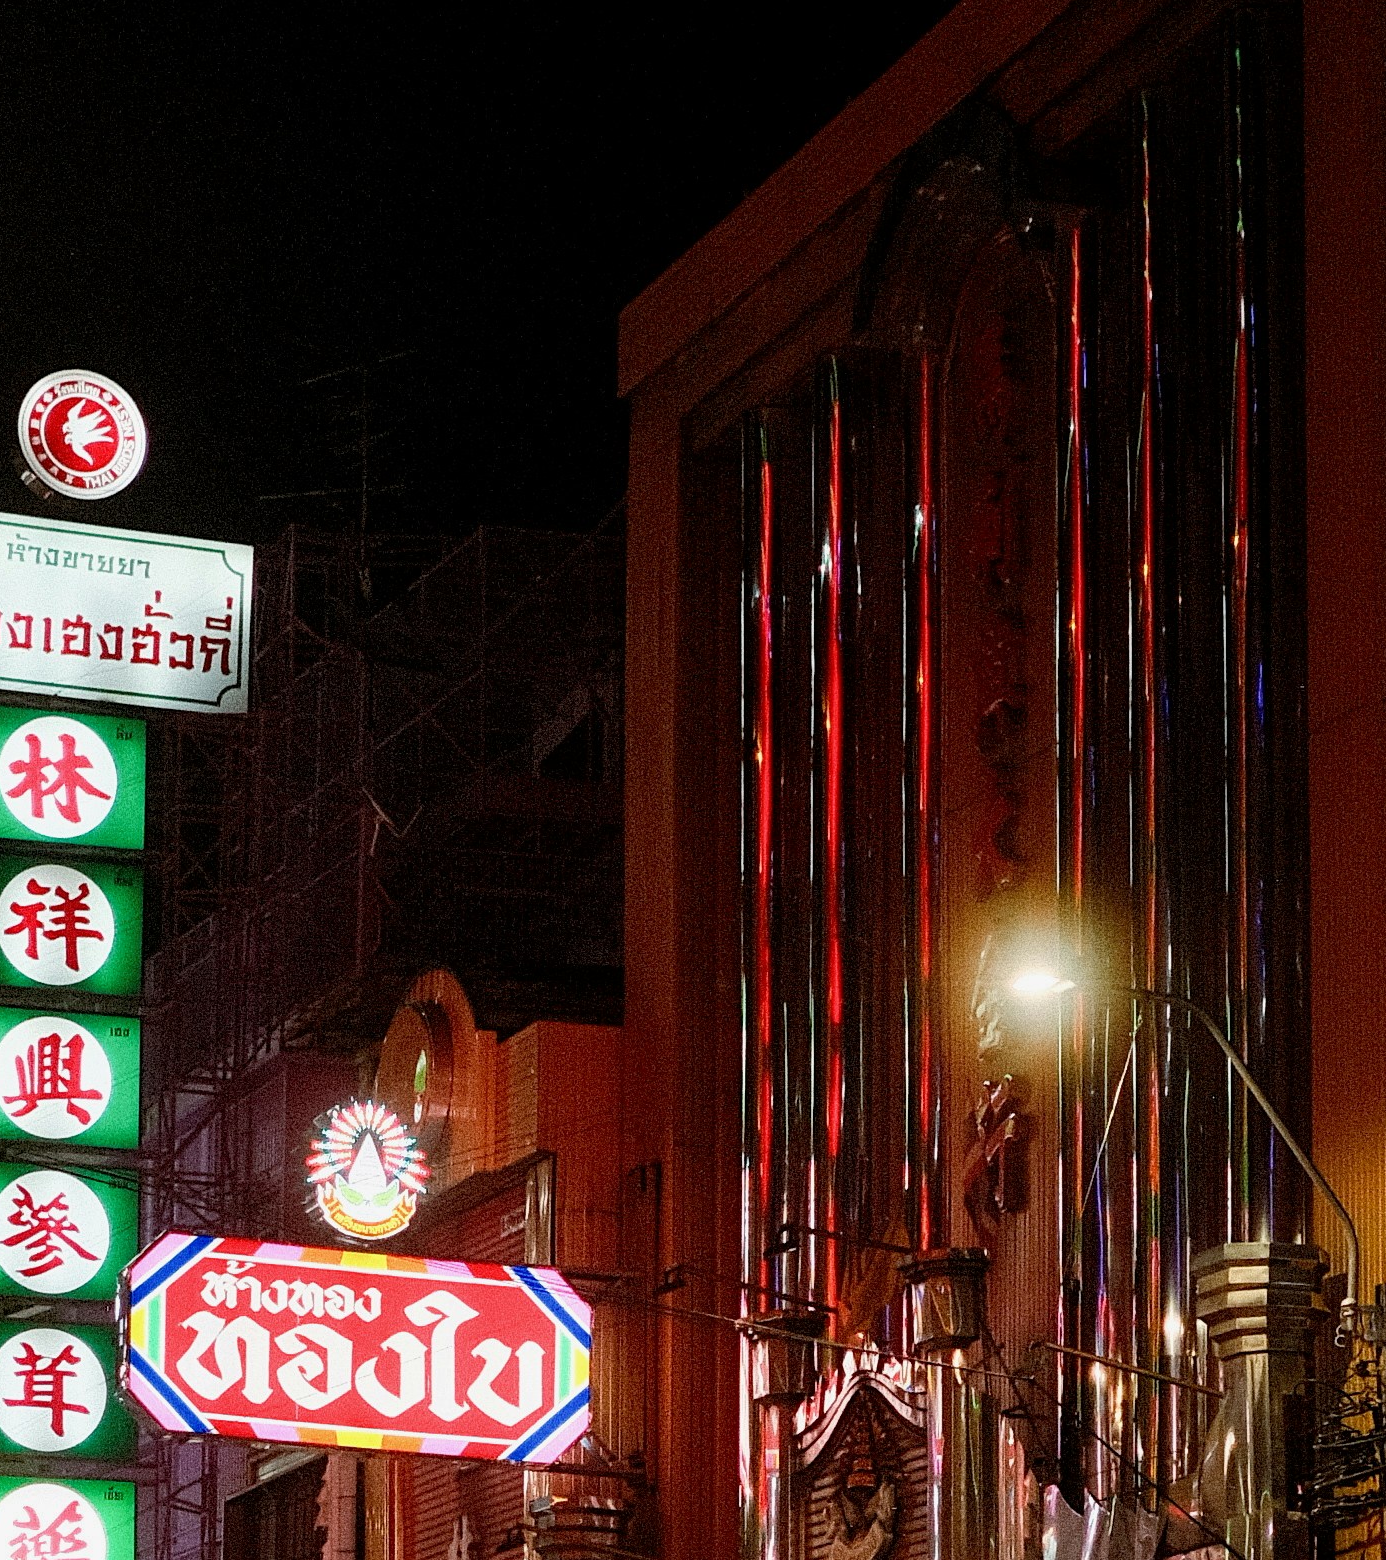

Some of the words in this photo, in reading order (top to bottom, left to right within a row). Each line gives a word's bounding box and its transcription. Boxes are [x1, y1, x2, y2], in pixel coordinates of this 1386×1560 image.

[82, 473, 115, 489] THAI
[114, 403, 136, 438] NEST
[6, 533, 152, 579] ห้างขายยา
[200, 1259, 381, 1322] ห้างทอง
[176, 1289, 548, 1427] ทองใบ
